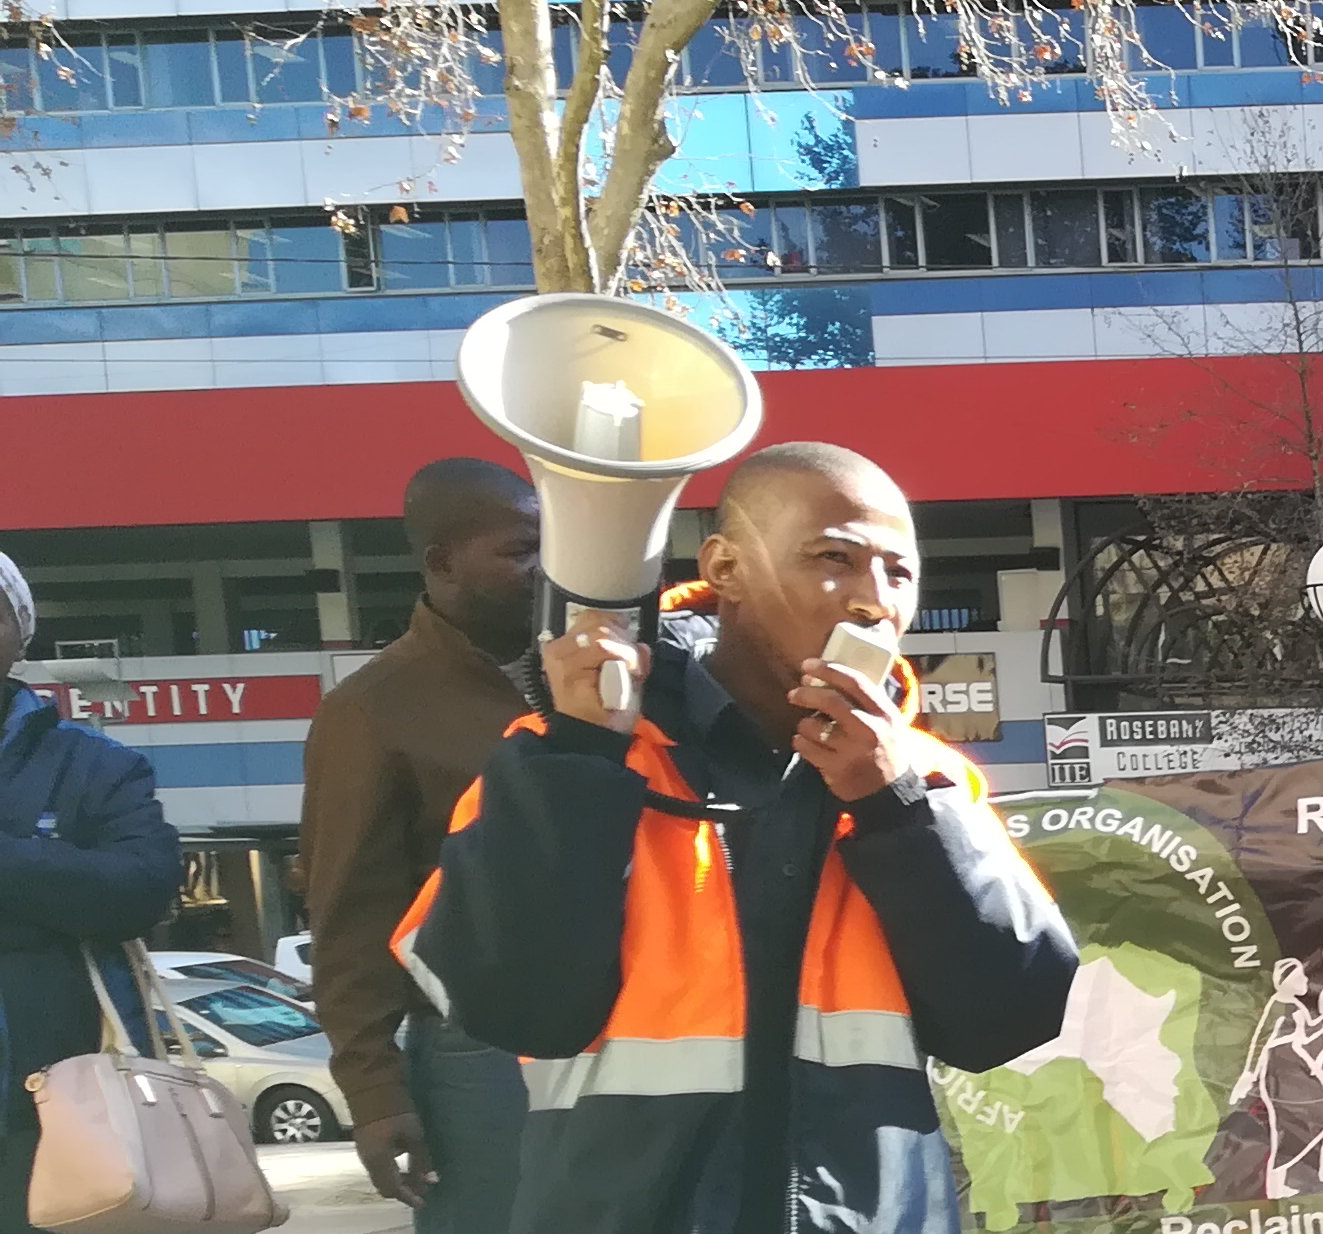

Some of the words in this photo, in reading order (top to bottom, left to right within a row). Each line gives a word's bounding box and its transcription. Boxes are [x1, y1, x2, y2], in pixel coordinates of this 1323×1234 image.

[1117, 749, 1201, 770] COLLEGE
[1053, 764, 1091, 783] IIE
[1042, 806, 1261, 968] ORGANISATION
